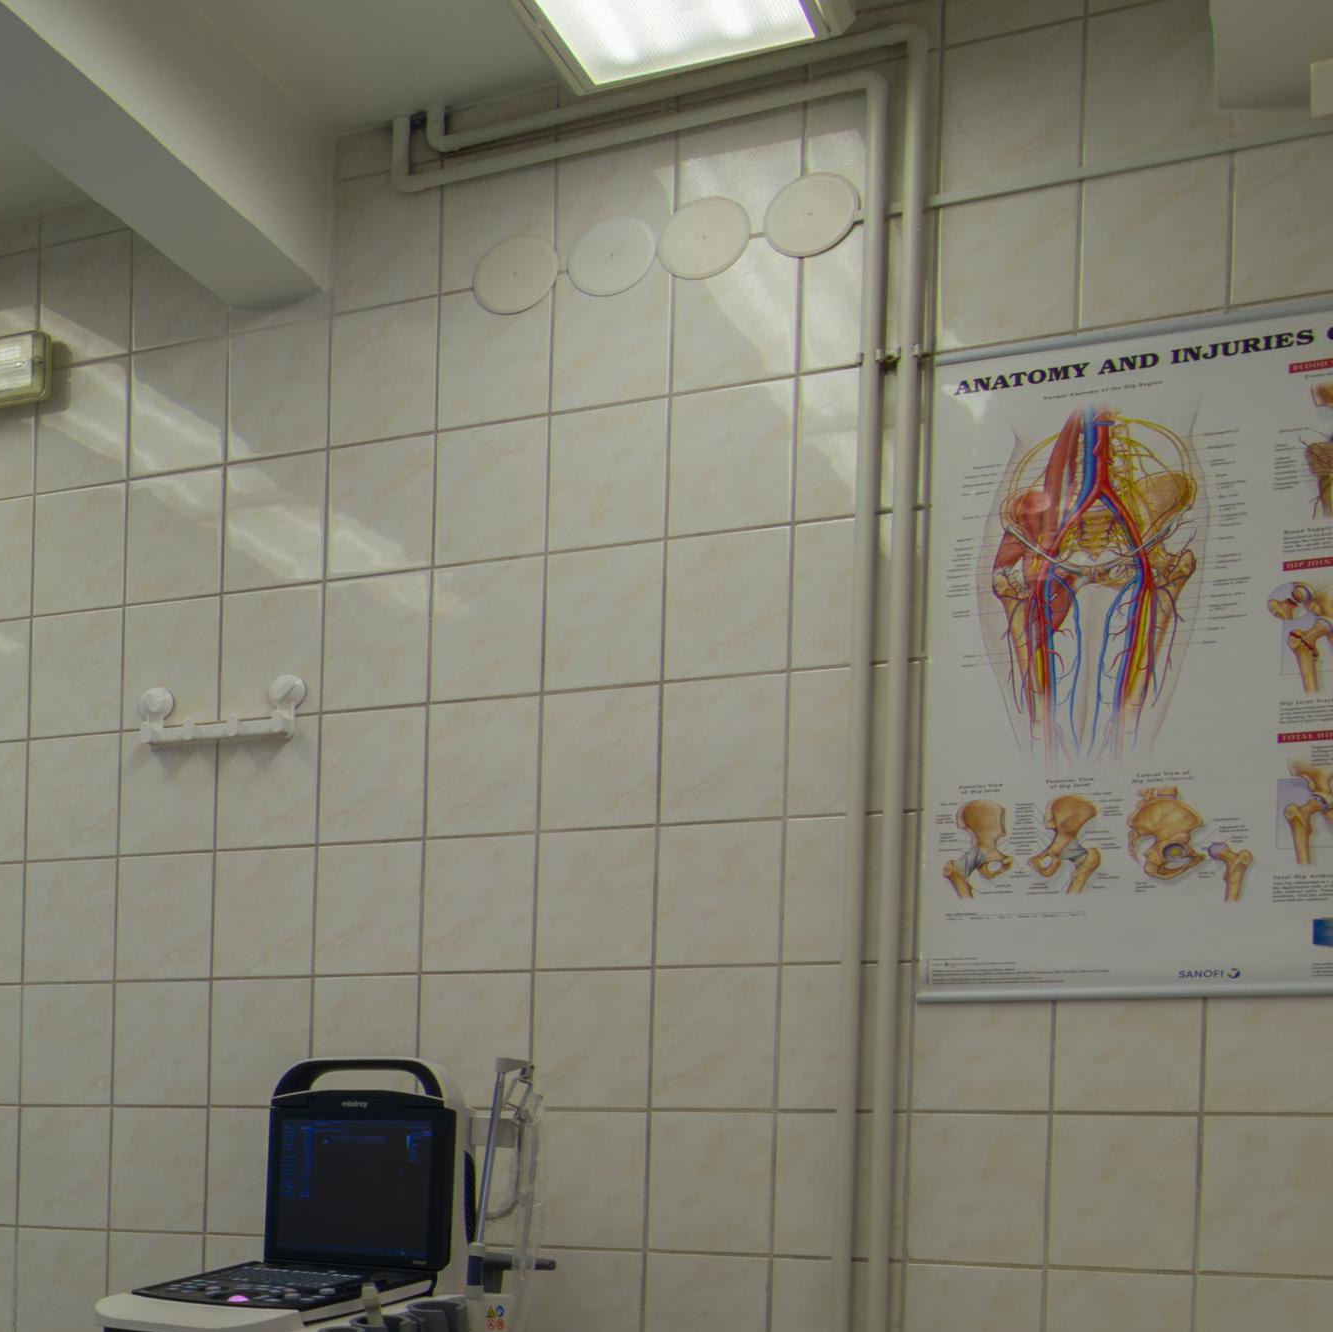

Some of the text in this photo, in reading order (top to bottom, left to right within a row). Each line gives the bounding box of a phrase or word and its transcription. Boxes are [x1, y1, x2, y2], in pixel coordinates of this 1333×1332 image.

[954, 362, 1090, 395] ANATOMY
[1098, 352, 1160, 376] AND
[1170, 329, 1315, 366] INJURIES
[1292, 361, 1328, 371] BLOOD
[1307, 558, 1333, 568] JOIN
[1178, 969, 1224, 979] SANOFI
